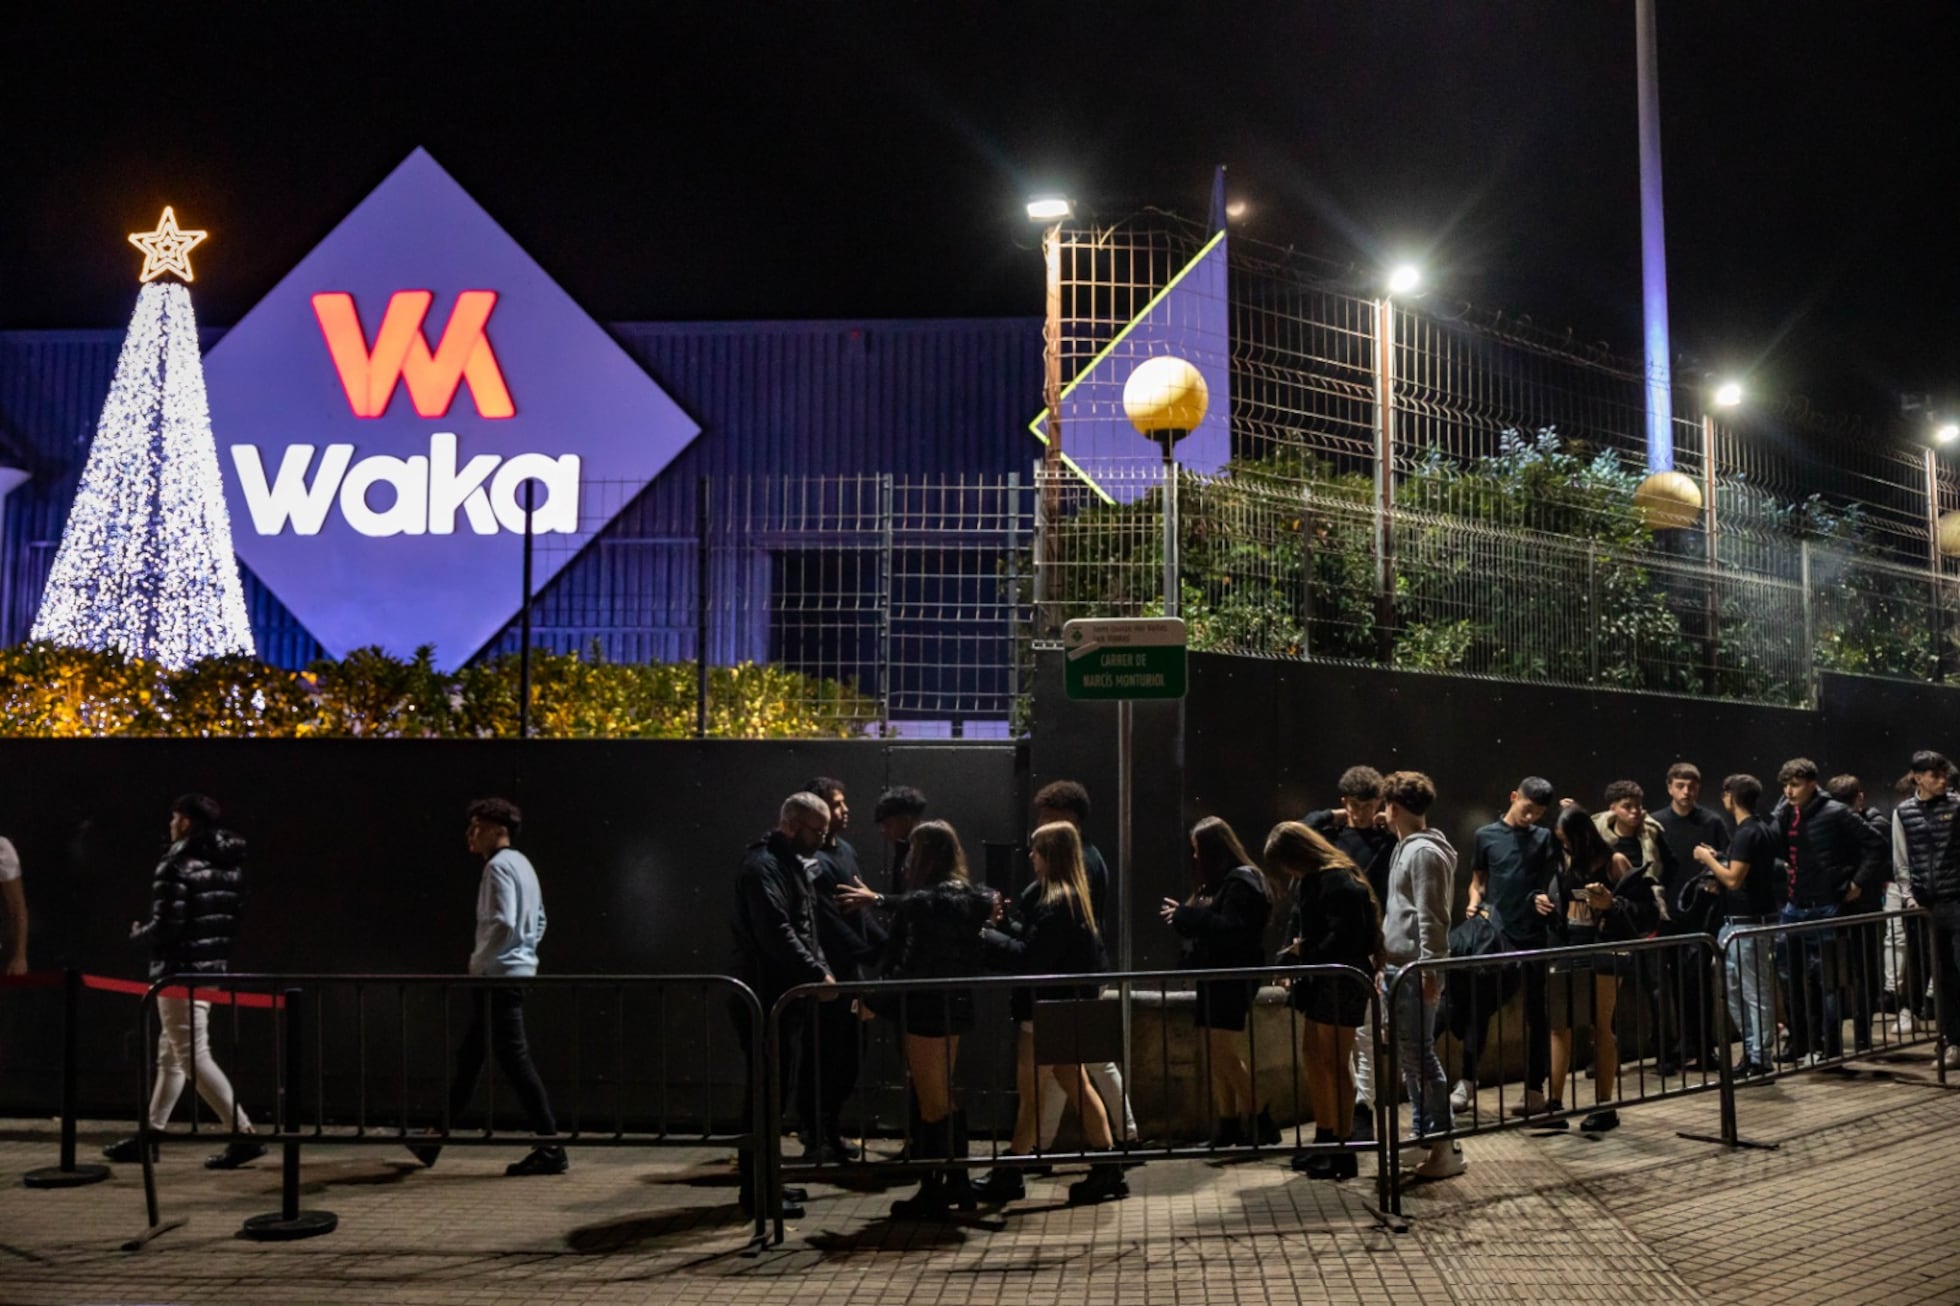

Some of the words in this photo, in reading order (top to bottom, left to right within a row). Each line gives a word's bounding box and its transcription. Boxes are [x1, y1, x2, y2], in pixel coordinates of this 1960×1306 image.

[1100, 653, 1134, 667] CARRER
[1135, 653, 1147, 667] DE
[1083, 671, 1113, 688] NARCÍS
[1115, 673, 1165, 687] MONTURIOL
